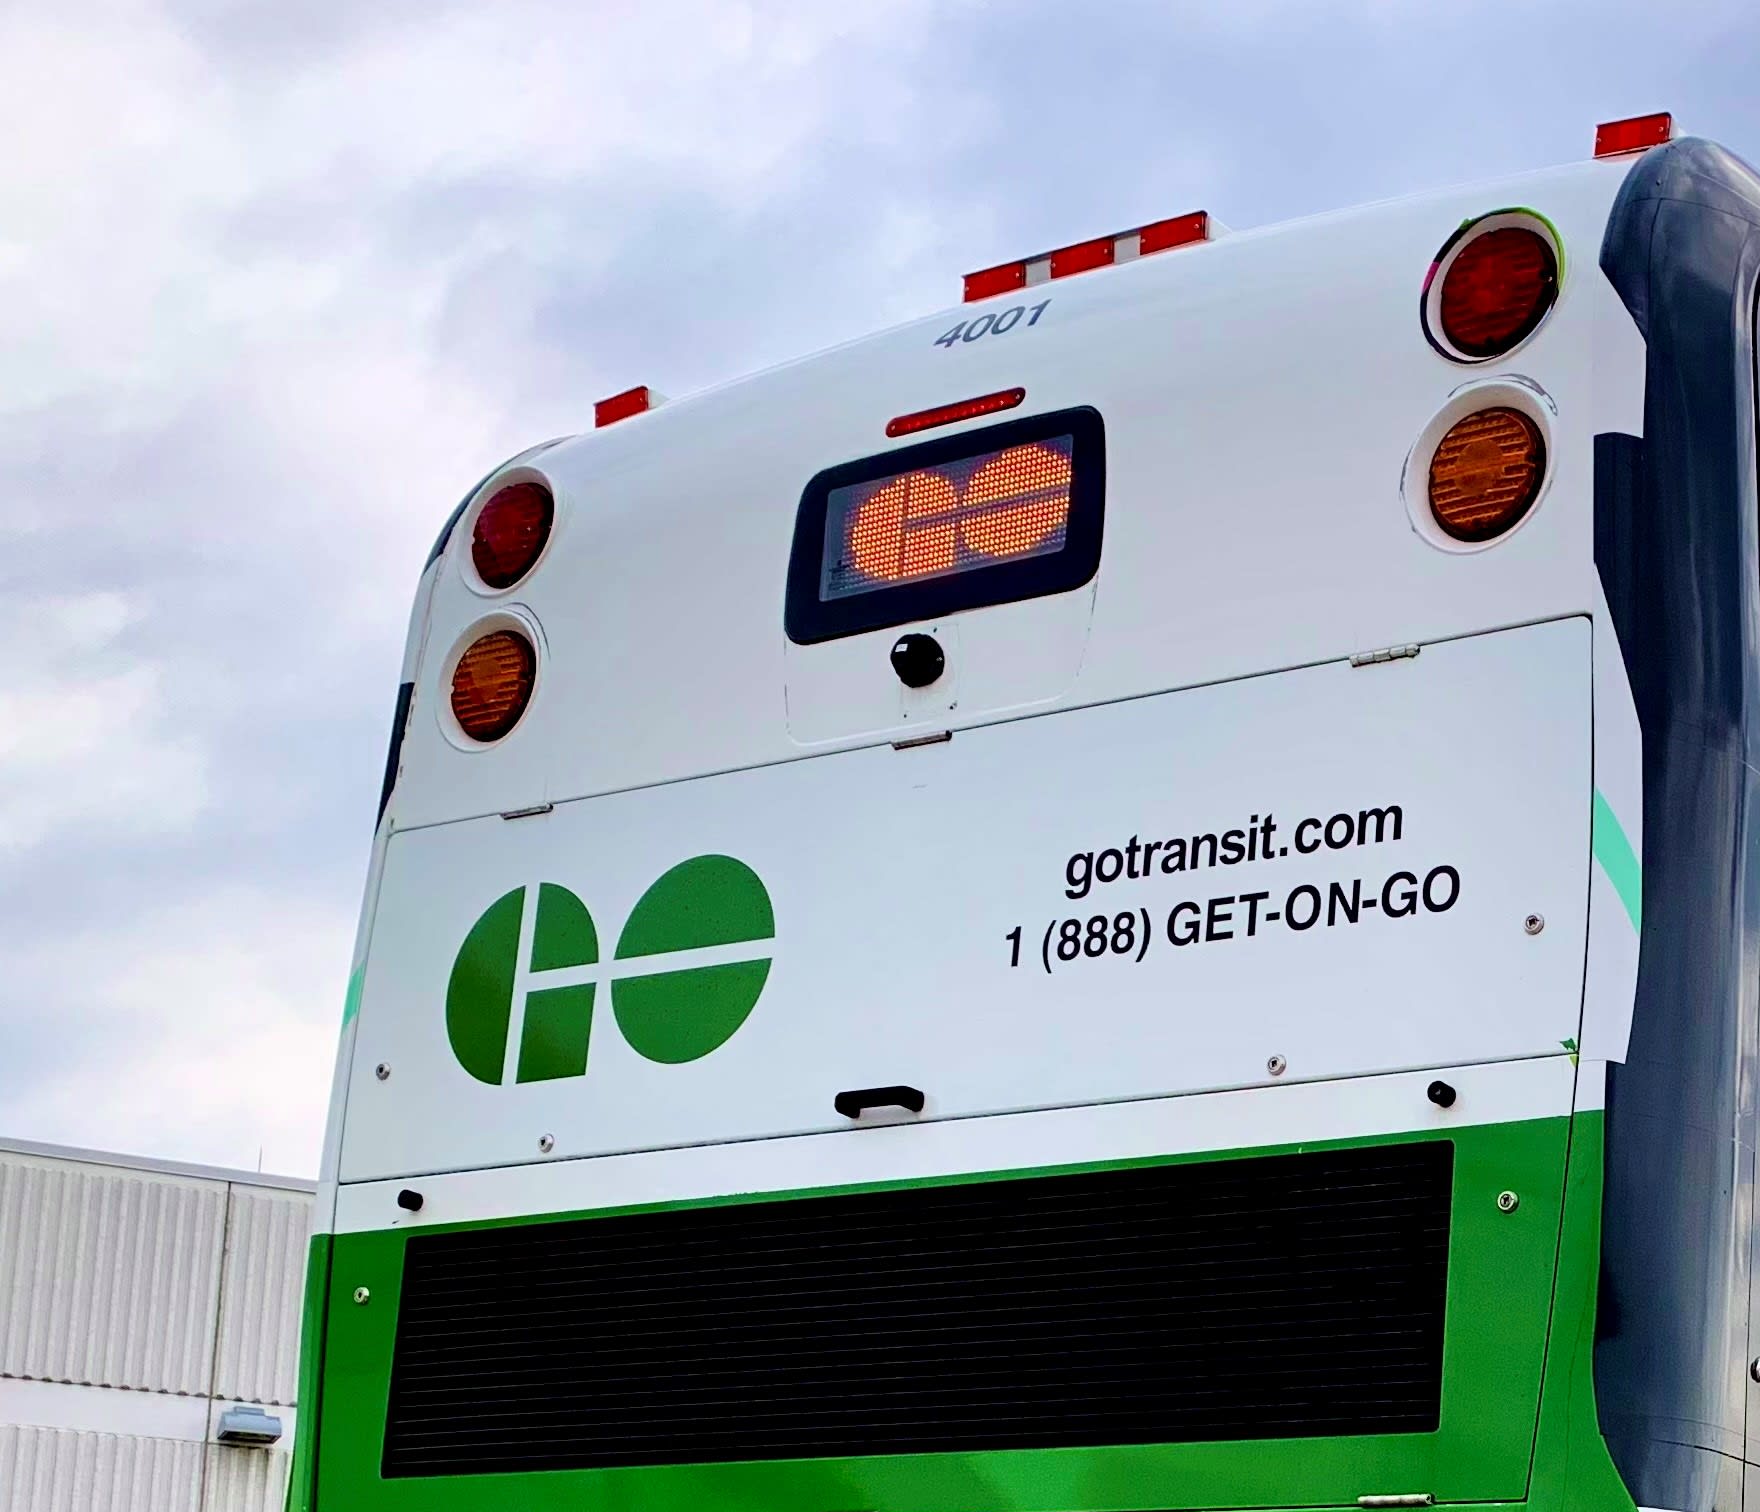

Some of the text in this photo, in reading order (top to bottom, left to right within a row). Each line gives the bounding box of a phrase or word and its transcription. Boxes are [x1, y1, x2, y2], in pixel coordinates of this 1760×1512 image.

[933, 299, 1053, 348] 4001
[1064, 805, 1403, 900] gotransit.com
[446, 853, 776, 1087] GO
[1004, 864, 1461, 974] 1 (888) GET-ON-GO
